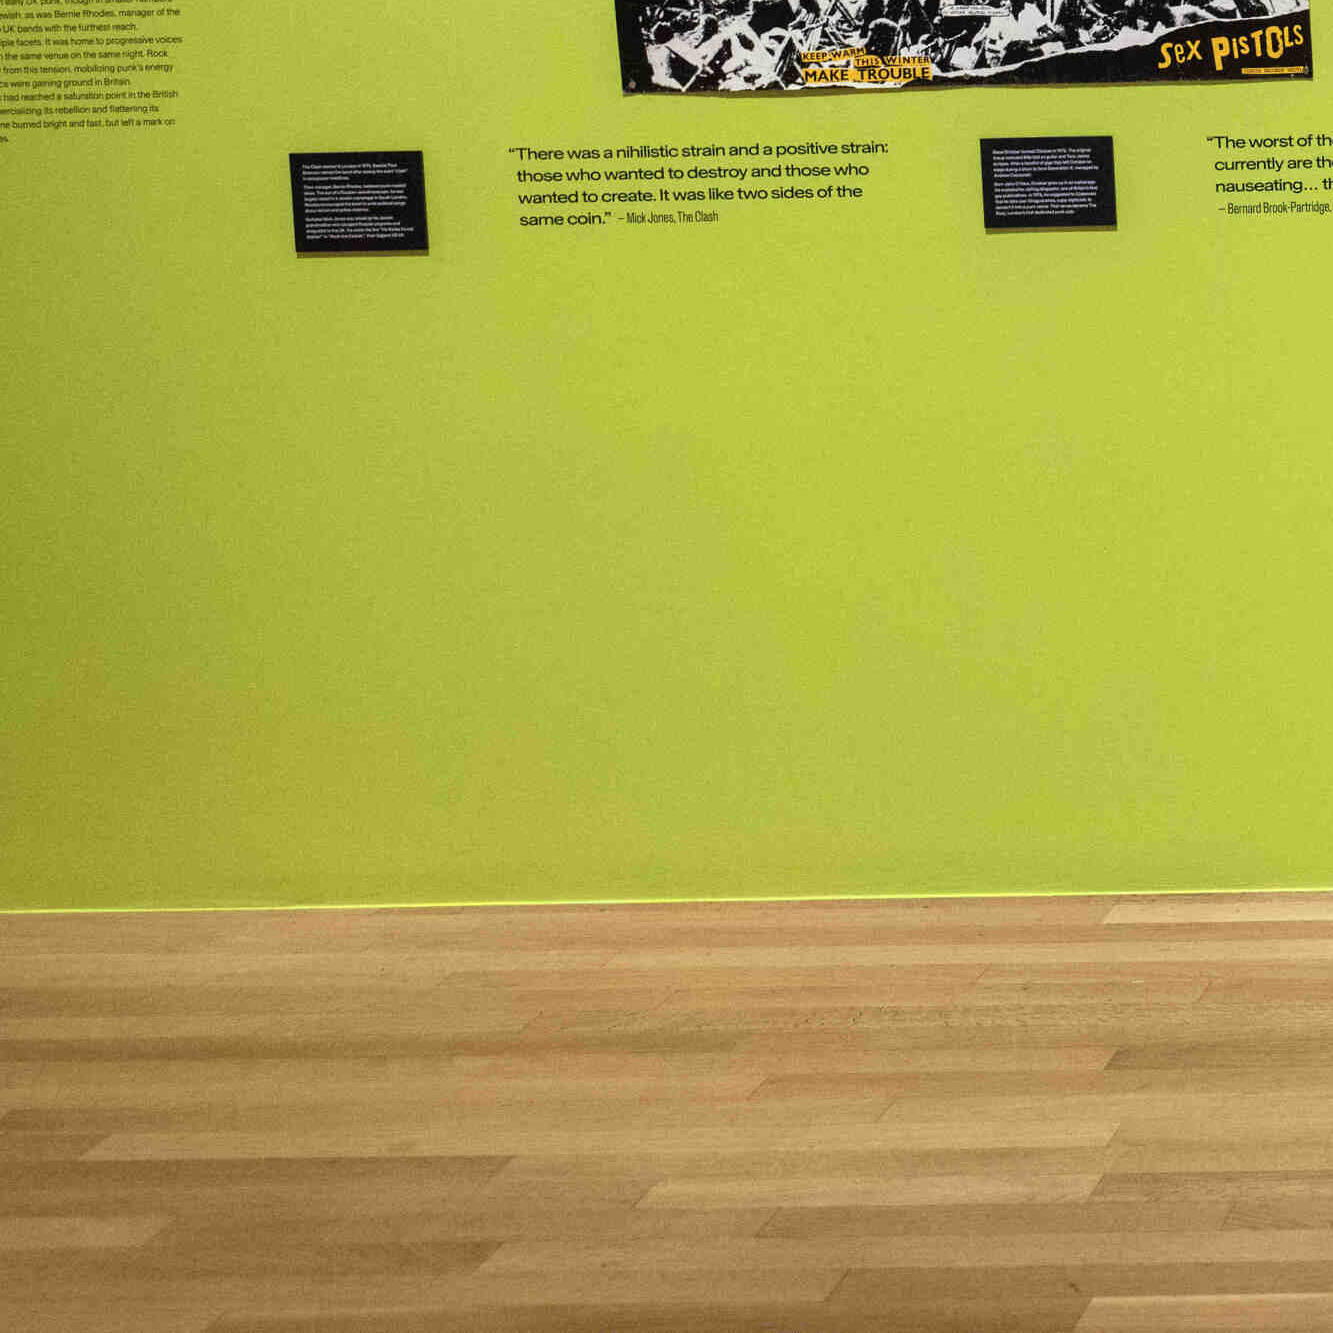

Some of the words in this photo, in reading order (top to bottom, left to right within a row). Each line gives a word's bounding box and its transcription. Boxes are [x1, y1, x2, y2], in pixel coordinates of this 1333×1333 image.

[805, 69, 851, 83] MAKE
[858, 67, 931, 82] TROUBLE
[566, 148, 601, 161] was
[603, 148, 614, 161] a
[616, 143, 679, 160] nihilistic
[681, 142, 726, 159] strain
[728, 142, 760, 157] and
[762, 144, 773, 156] a
[775, 140, 839, 159] positive
[840, 139, 889, 155] strain:
[1248, 134, 1295, 150] worst
[1296, 133, 1314, 148] of
